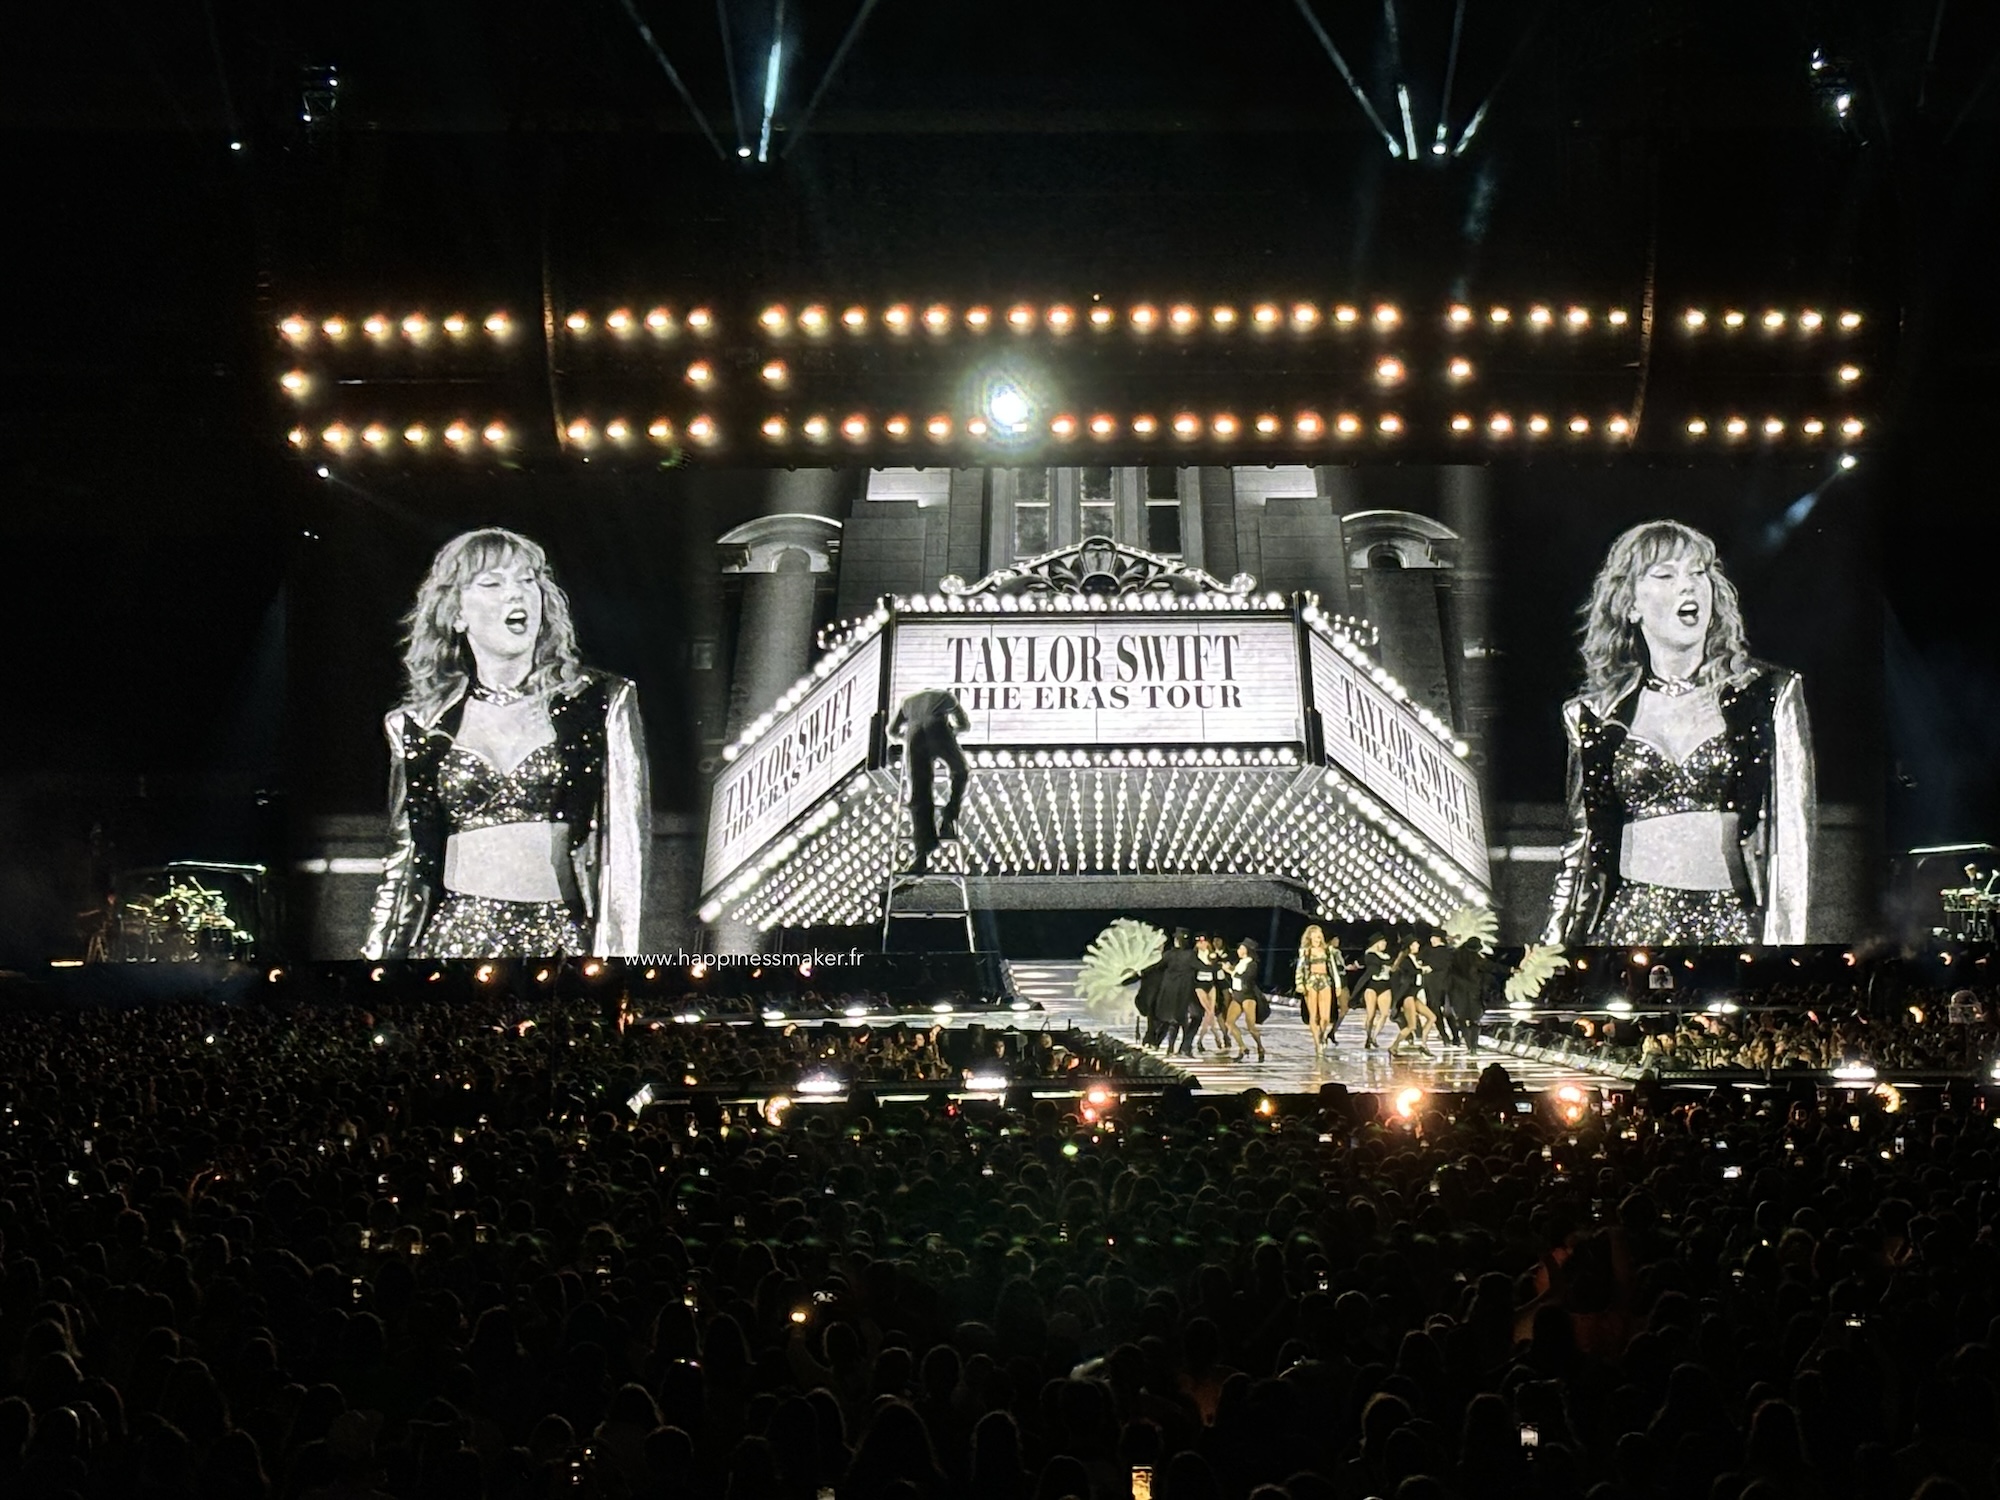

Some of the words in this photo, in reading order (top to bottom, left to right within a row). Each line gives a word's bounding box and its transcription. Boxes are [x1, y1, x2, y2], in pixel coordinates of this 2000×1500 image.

[946, 686, 1021, 710] THE
[1032, 686, 1130, 710] ERAS
[1141, 684, 1243, 709] TOUR
[947, 635, 1101, 683] TAYLOR
[1116, 634, 1239, 683] SWIFT
[722, 805, 754, 849] THE
[757, 764, 800, 819] ERAS
[804, 720, 852, 774] TOUR
[726, 734, 793, 825] TAYLOR
[797, 675, 857, 762] SWIFT
[1340, 674, 1416, 775] TAYLOR
[1419, 742, 1471, 821] SWIFT
